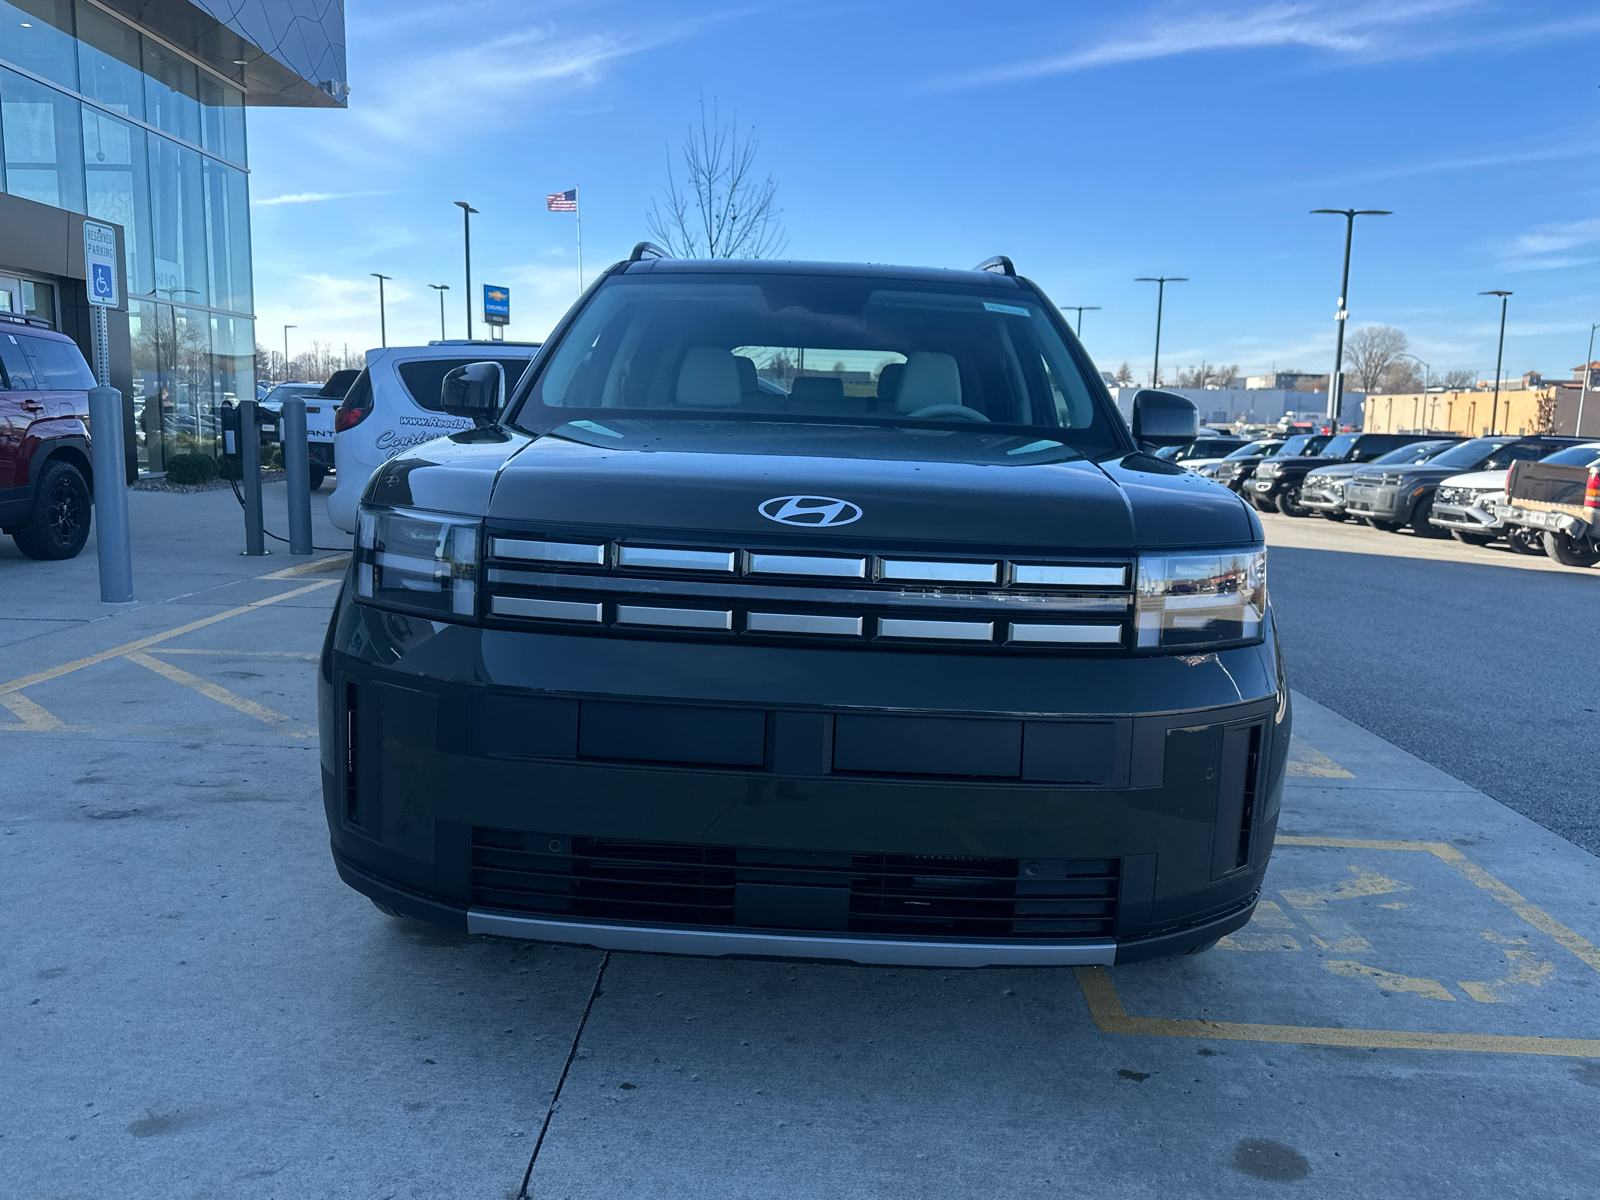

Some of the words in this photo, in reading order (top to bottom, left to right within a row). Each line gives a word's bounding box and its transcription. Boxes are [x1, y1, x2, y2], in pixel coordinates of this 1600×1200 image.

[87, 229, 112, 245] RESERVED
[88, 244, 113, 259] PARKING
[486, 304, 508, 312] CHEVROLET
[399, 416, 477, 430] www.ReedJee
